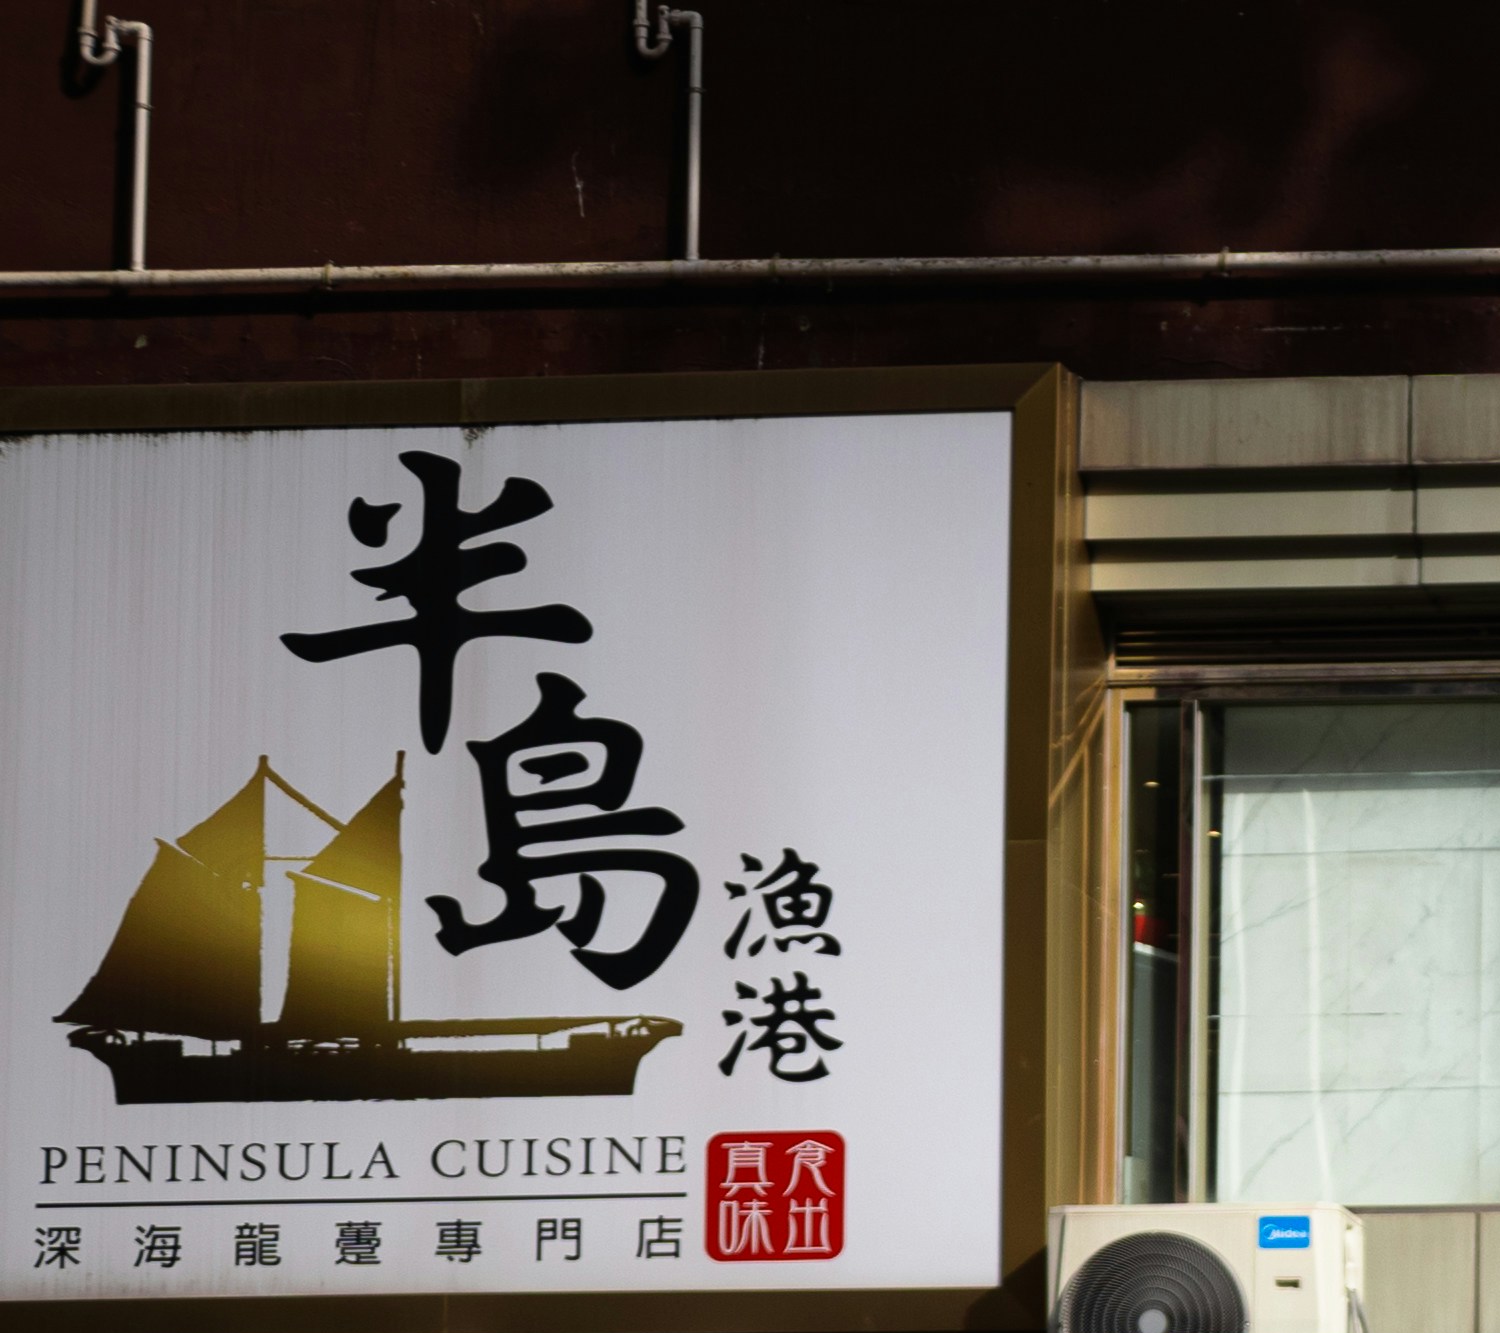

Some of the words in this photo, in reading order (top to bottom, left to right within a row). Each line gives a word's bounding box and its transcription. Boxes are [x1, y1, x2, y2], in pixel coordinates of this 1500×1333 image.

[280, 450, 700, 991] 半島
[718, 847, 844, 1083] 漁港
[40, 1142, 399, 1185] PENINSULA
[431, 1136, 686, 1178] CUISINE
[33, 1215, 683, 1270] 深海龍躉專門店
